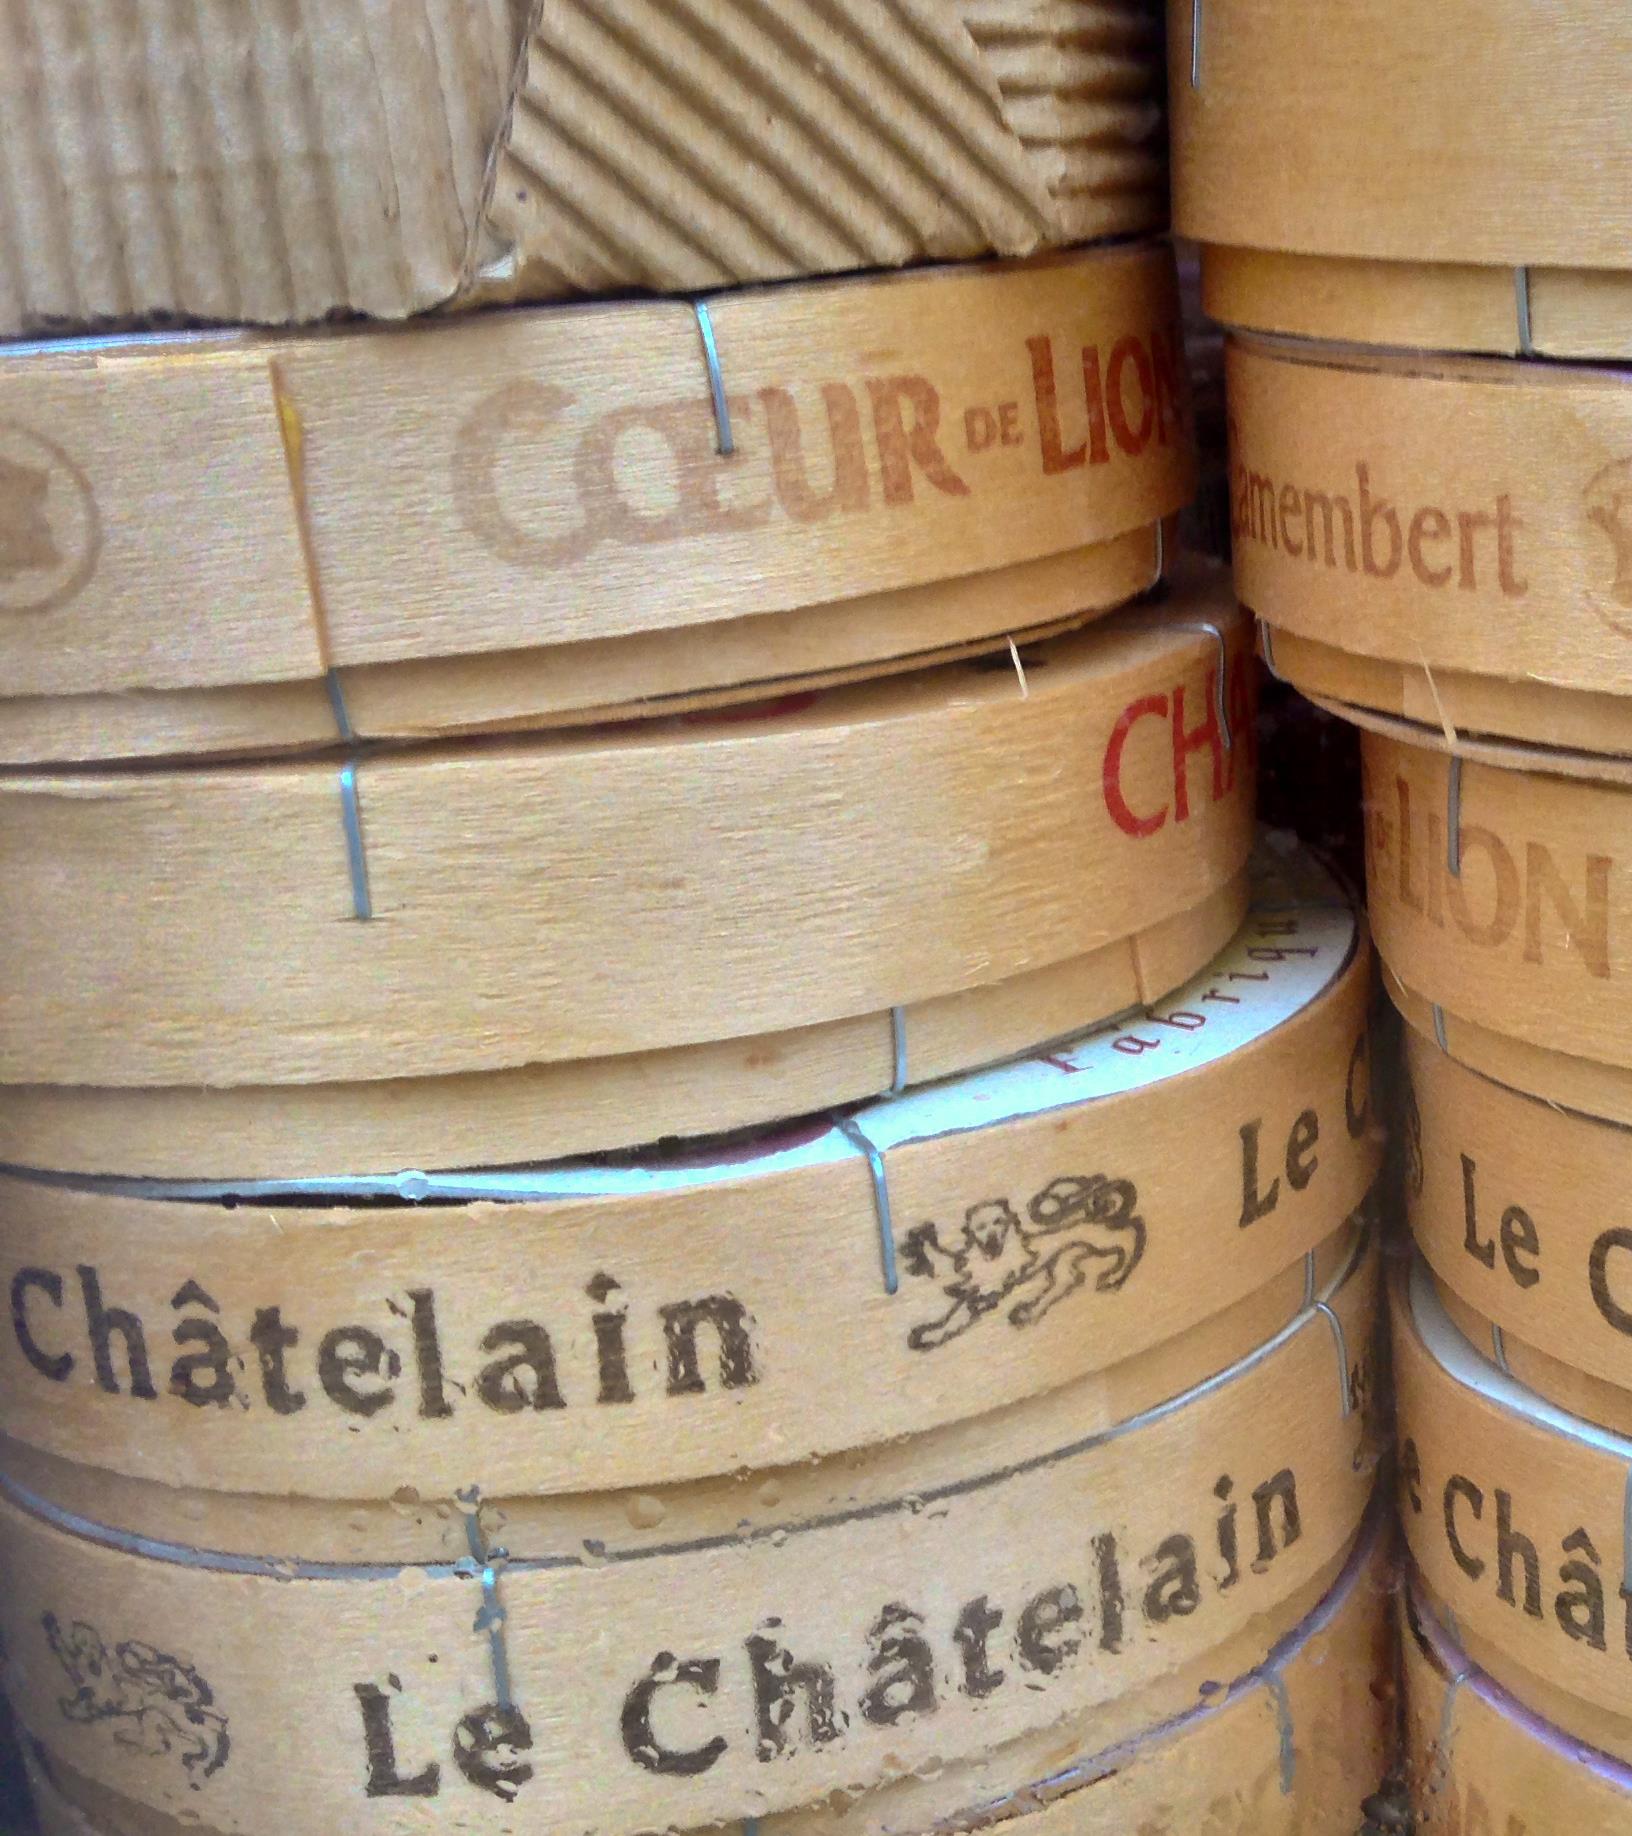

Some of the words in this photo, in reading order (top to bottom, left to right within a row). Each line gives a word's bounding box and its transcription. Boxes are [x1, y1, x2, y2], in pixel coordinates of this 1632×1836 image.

[965, 402, 1024, 453] DE
[1228, 412, 1529, 597] amembert
[1397, 775, 1613, 980] LION
[1238, 1107, 1320, 1229] Le
[1460, 1152, 1540, 1288] Le
[10, 1264, 758, 1420] Châtelain
[355, 1674, 533, 1799] Le
[621, 1467, 1301, 1778] Châtelain
